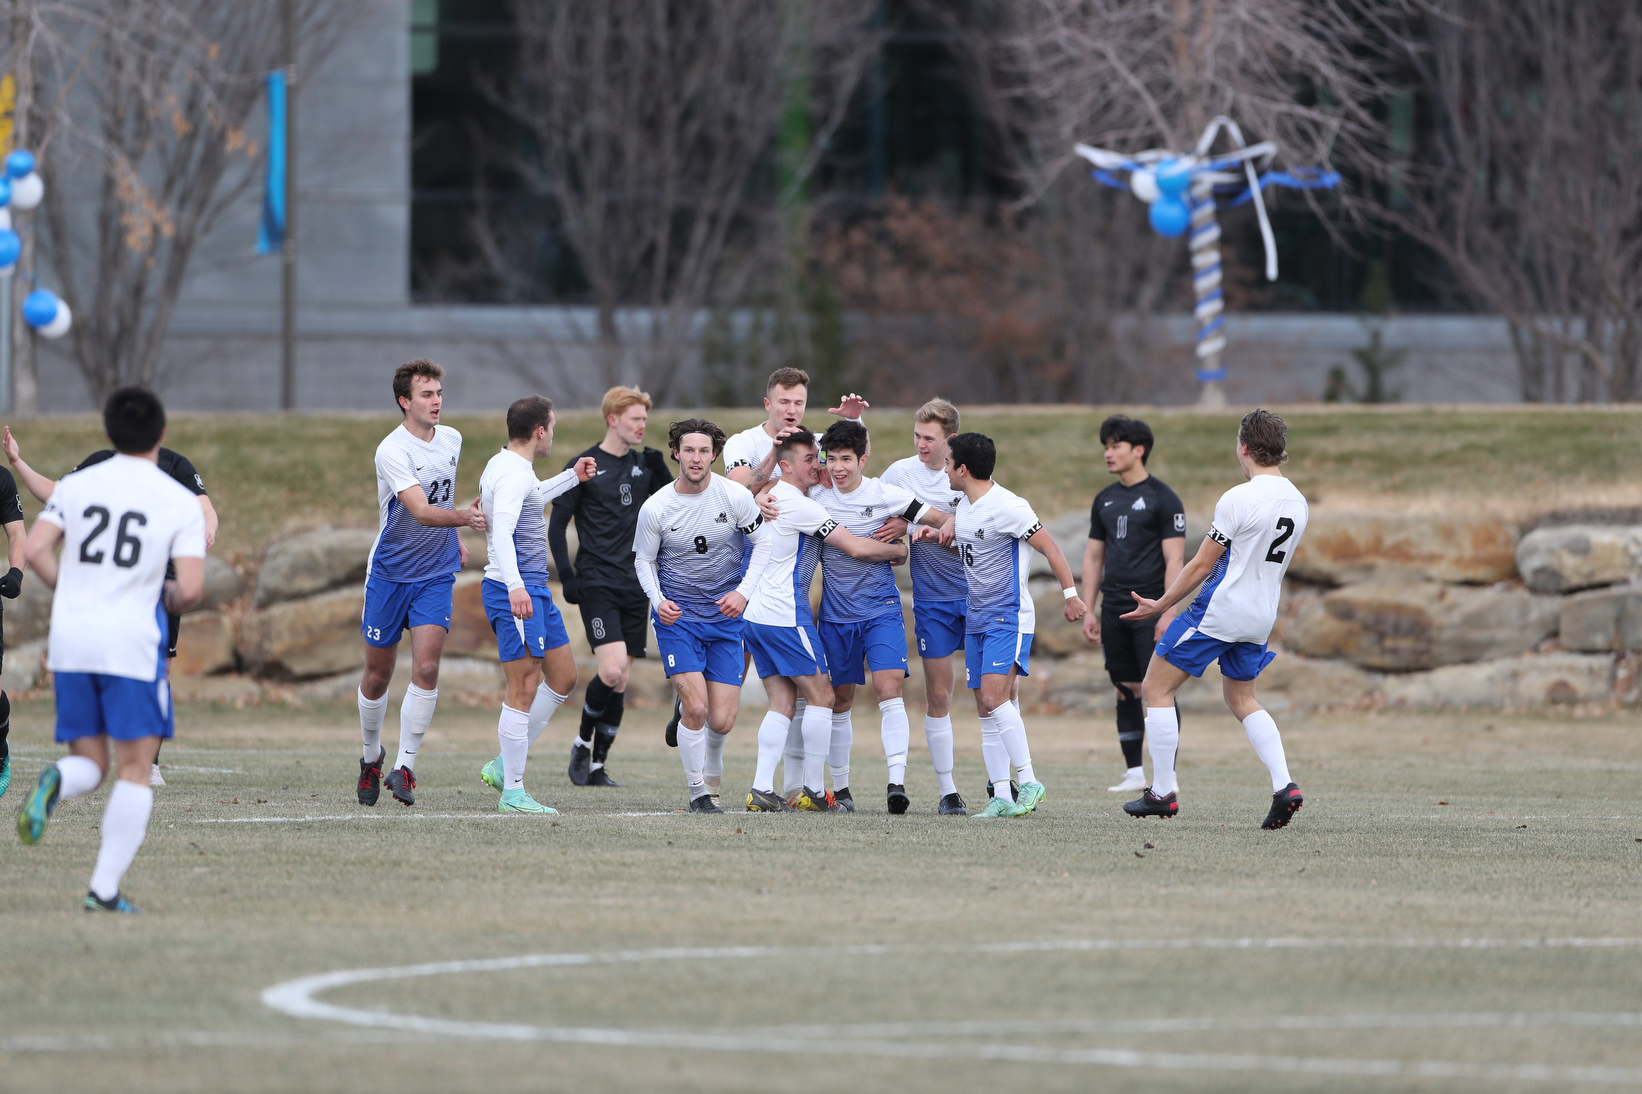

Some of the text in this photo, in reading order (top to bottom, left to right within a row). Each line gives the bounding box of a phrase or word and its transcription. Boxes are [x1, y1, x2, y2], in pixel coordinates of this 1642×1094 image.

[428, 479, 451, 504] 23
[620, 483, 632, 505] 8
[79, 504, 147, 568] 26
[1116, 515, 1128, 539] 11
[694, 535, 708, 554] 8
[1265, 517, 1295, 564] 2
[961, 543, 974, 567] 16
[367, 625, 381, 640] 23
[592, 617, 606, 639] 8
[538, 636, 545, 650] 9
[920, 637, 926, 651] 6
[667, 654, 676, 668] 8
